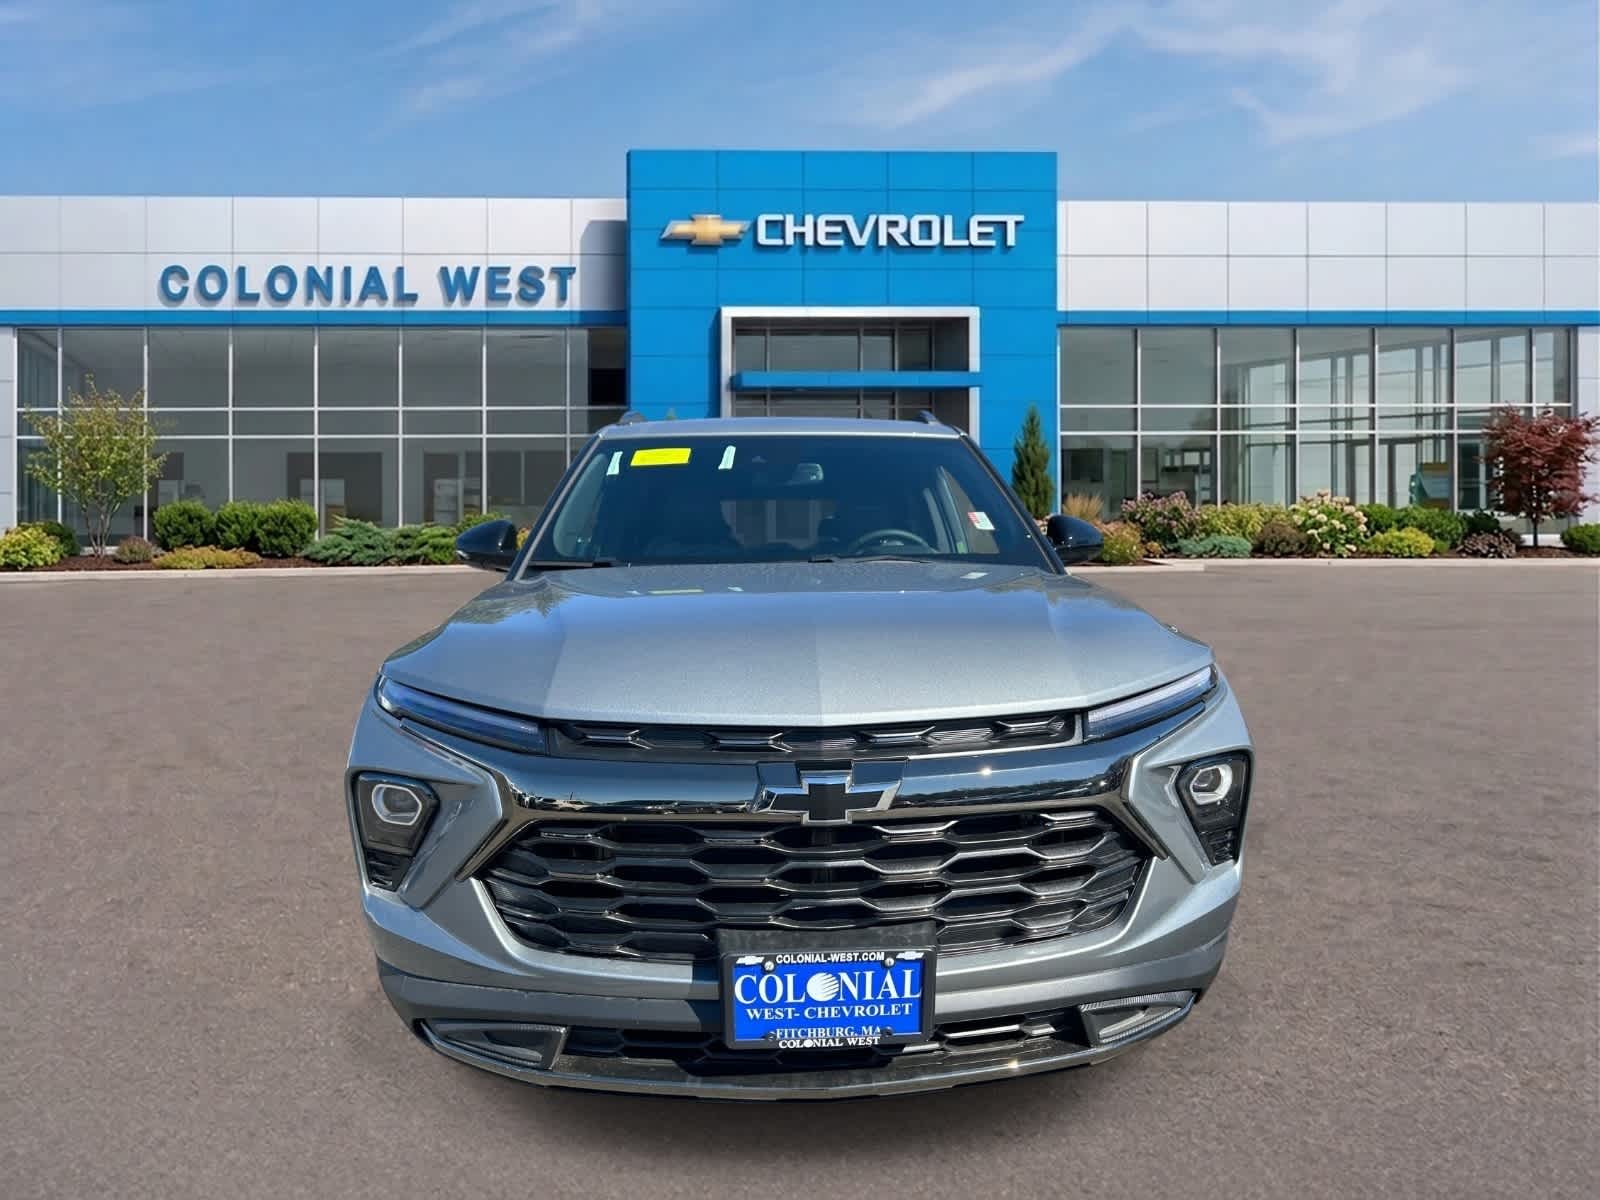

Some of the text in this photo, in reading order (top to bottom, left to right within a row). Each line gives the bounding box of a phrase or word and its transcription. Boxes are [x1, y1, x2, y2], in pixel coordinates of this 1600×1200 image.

[756, 213, 1024, 247] CHEVROLET
[160, 265, 577, 306] COLONIAL WEST
[775, 952, 885, 964] COLONIAL-WEST.COM
[734, 969, 922, 1005] COLONIAL
[804, 1003, 912, 1019] CHEVROLET
[861, 1025, 881, 1037] MA
[778, 1036, 881, 1049] COLONIAL WEST
